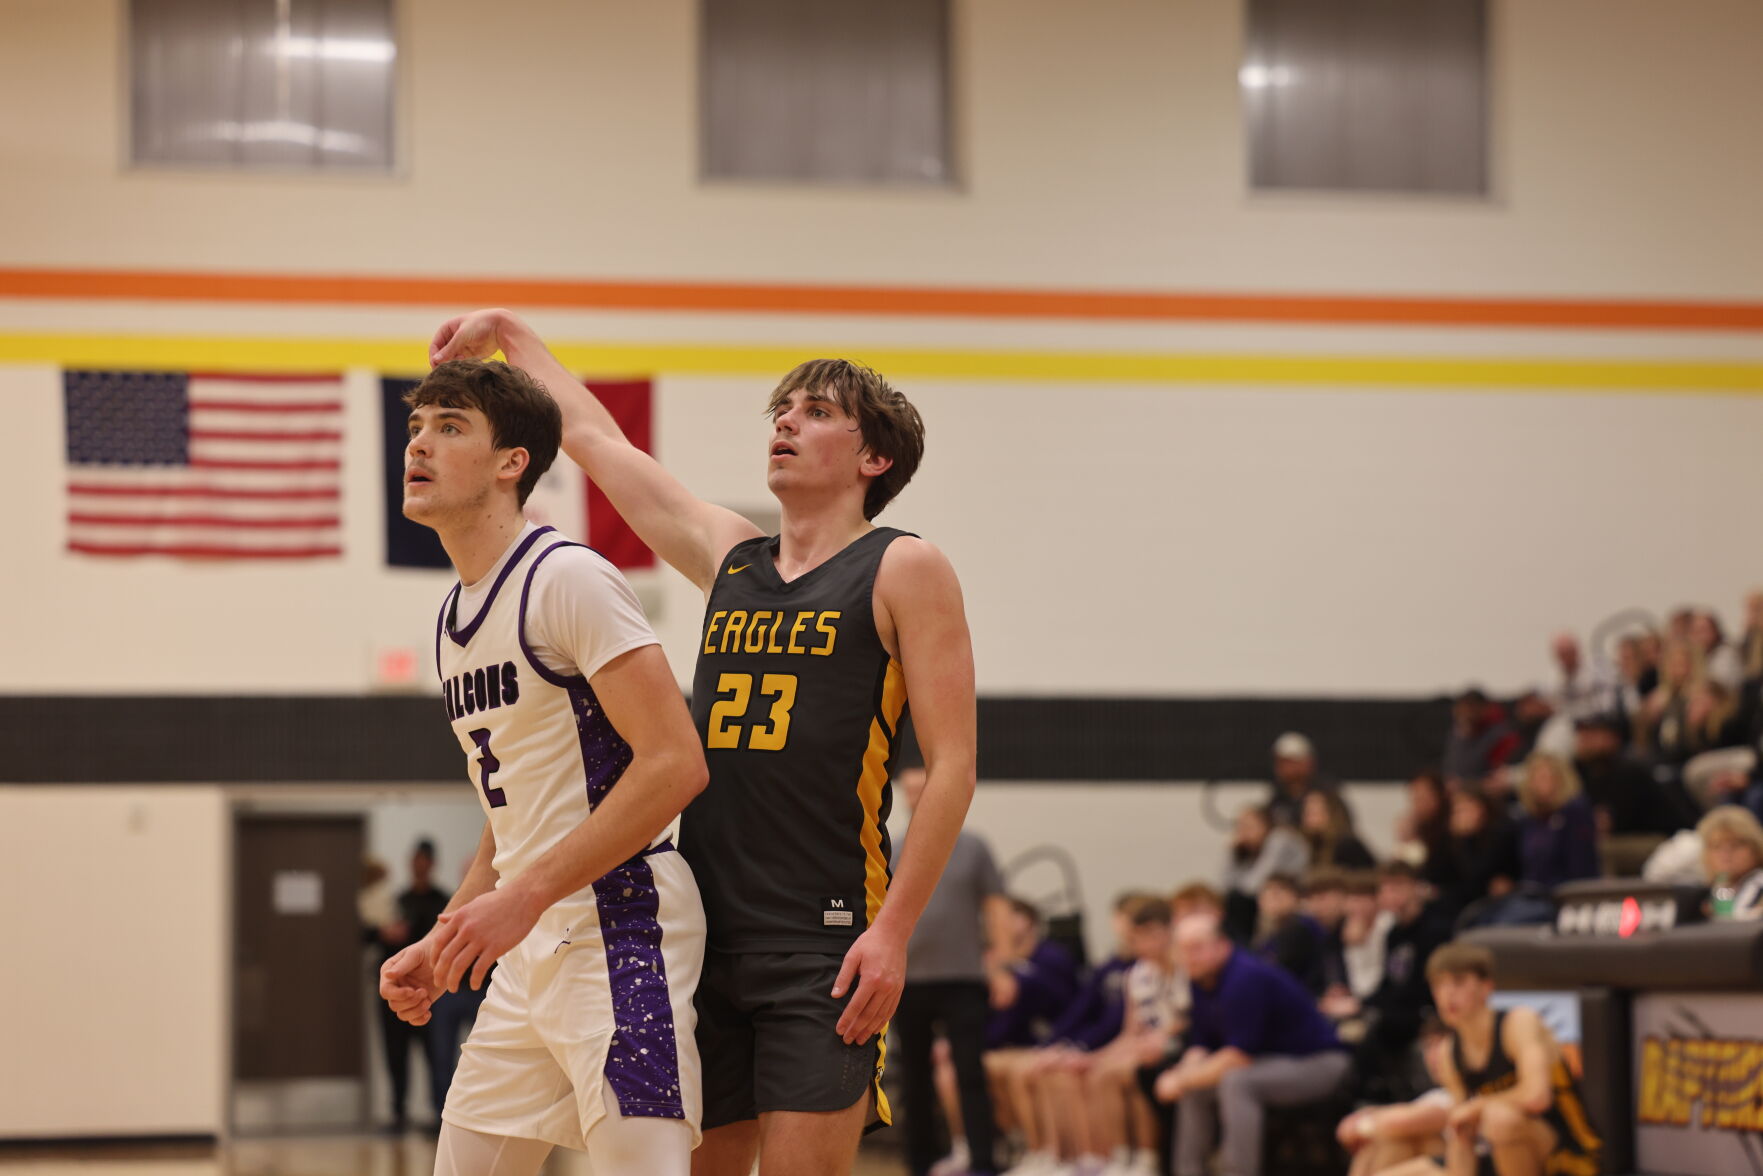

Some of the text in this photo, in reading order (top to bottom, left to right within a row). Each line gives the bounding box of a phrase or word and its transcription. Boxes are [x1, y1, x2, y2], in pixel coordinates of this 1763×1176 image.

[703, 610, 842, 657] EAGLES
[707, 672, 799, 752] 23
[468, 727, 508, 809] 2
[830, 899, 844, 908] M
